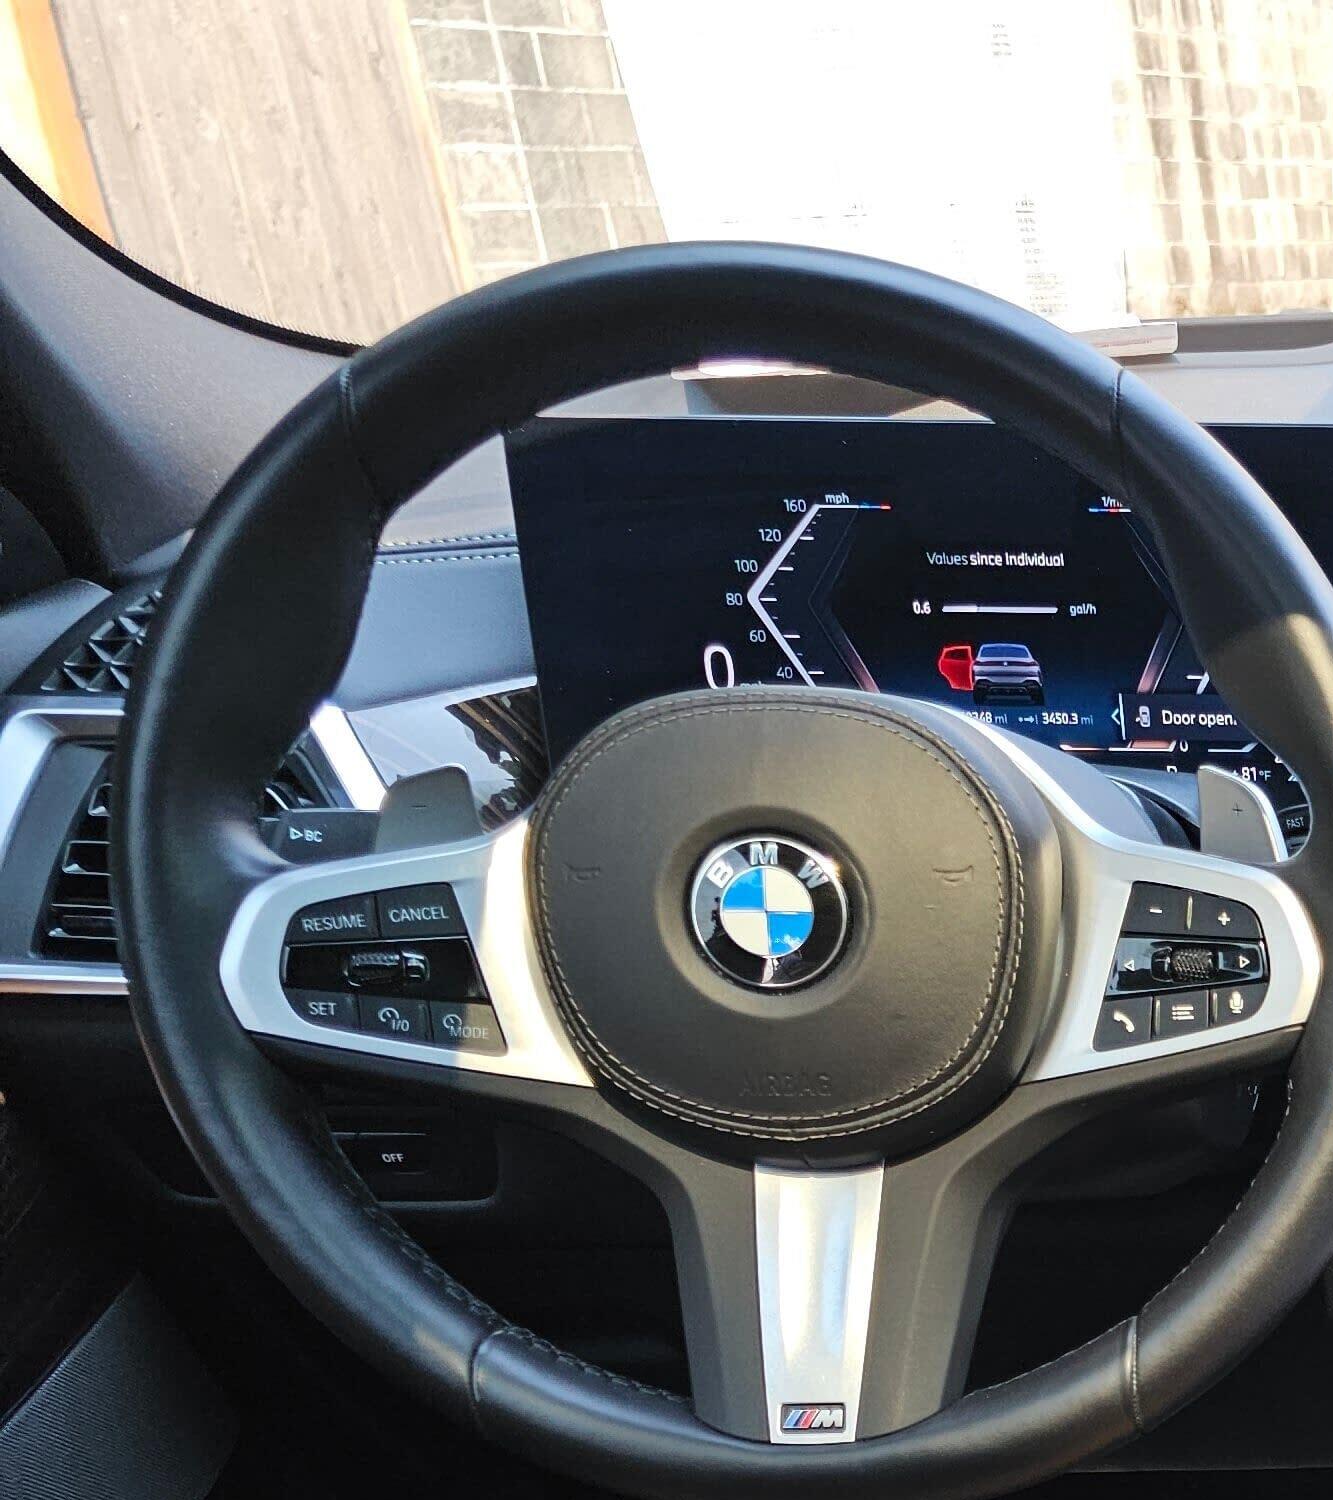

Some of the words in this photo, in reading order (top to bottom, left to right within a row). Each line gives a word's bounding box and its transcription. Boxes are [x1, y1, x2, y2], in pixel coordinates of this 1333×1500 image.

[825, 493, 850, 504] mph
[784, 499, 807, 513] 160
[759, 529, 782, 542] 120
[926, 552, 968, 566] Values
[969, 552, 1002, 566] since
[1005, 553, 1064, 567] Individual
[735, 560, 758, 573] 100
[726, 593, 743, 606] 80
[912, 602, 932, 615] 0.6
[1069, 603, 1097, 617] gal/h
[750, 630, 766, 642] 60
[704, 645, 735, 690] 0
[776, 667, 793, 679] 40
[994, 714, 1008, 724] mi
[1042, 712, 1079, 725] 3450.3
[1081, 715, 1093, 725] mi
[1162, 710, 1195, 725] Door
[1286, 817, 1305, 829] FAST
[706, 841, 830, 889] BMW
[388, 906, 449, 924] CANCEL
[302, 915, 367, 932] RESUME
[309, 1002, 336, 1016] SET
[450, 1025, 489, 1040] MODE
[381, 1152, 405, 1164] OFF
